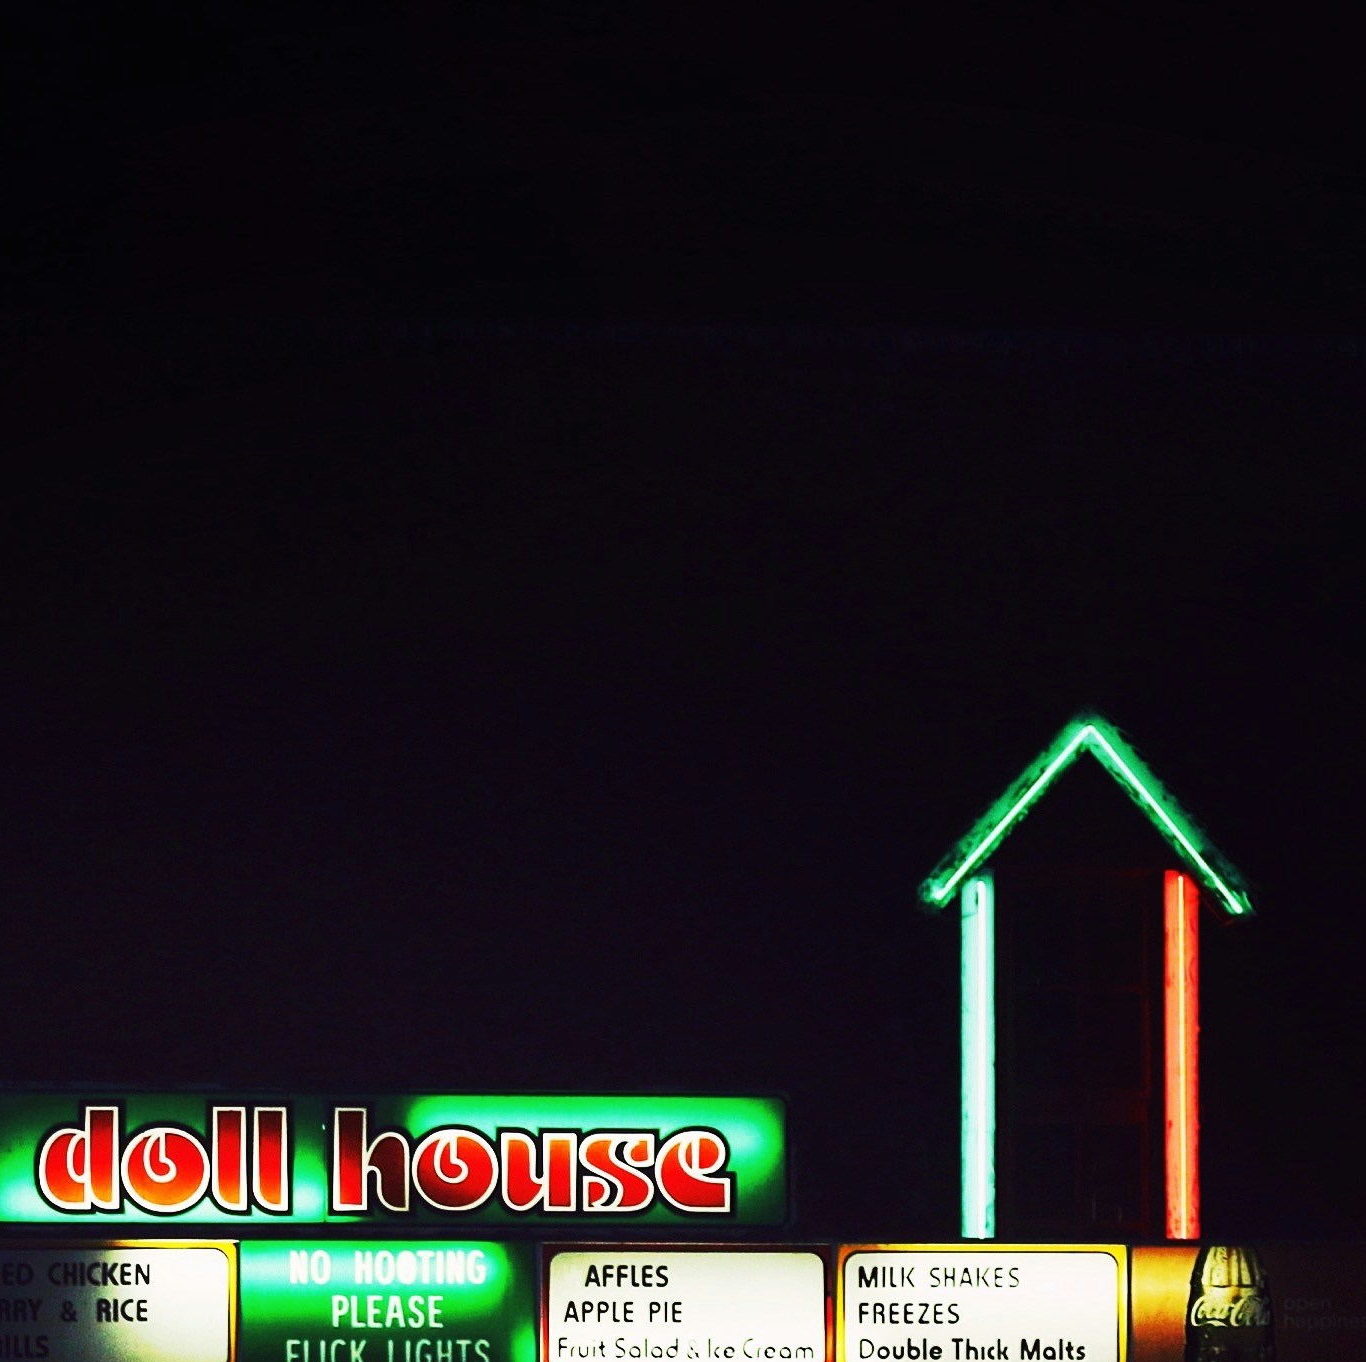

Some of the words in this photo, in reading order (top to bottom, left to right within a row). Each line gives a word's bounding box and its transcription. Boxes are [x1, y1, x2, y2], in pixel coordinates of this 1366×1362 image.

[37, 1106, 290, 1213] doll
[332, 1106, 732, 1213] house
[48, 1262, 151, 1287] CHICKEN
[288, 1249, 332, 1285] NO
[354, 1250, 486, 1286] HOOTING
[857, 1265, 916, 1289] MILK
[929, 1266, 1021, 1288] SHAKES
[61, 1300, 78, 1322] &
[96, 1299, 149, 1323] RICE
[331, 1294, 444, 1329] PLEASE
[563, 1300, 634, 1323] APPLE
[648, 1301, 683, 1323] PIE
[858, 1302, 961, 1325] FREEZES
[1284, 1298, 1331, 1312] open
[558, 1337, 607, 1359] Fruit
[614, 1337, 679, 1359] Salad
[707, 1338, 736, 1360] Ice
[742, 1338, 815, 1360] Cream
[858, 1337, 943, 1361] Double
[951, 1337, 1010, 1361] Thick
[1019, 1337, 1087, 1361] Malts
